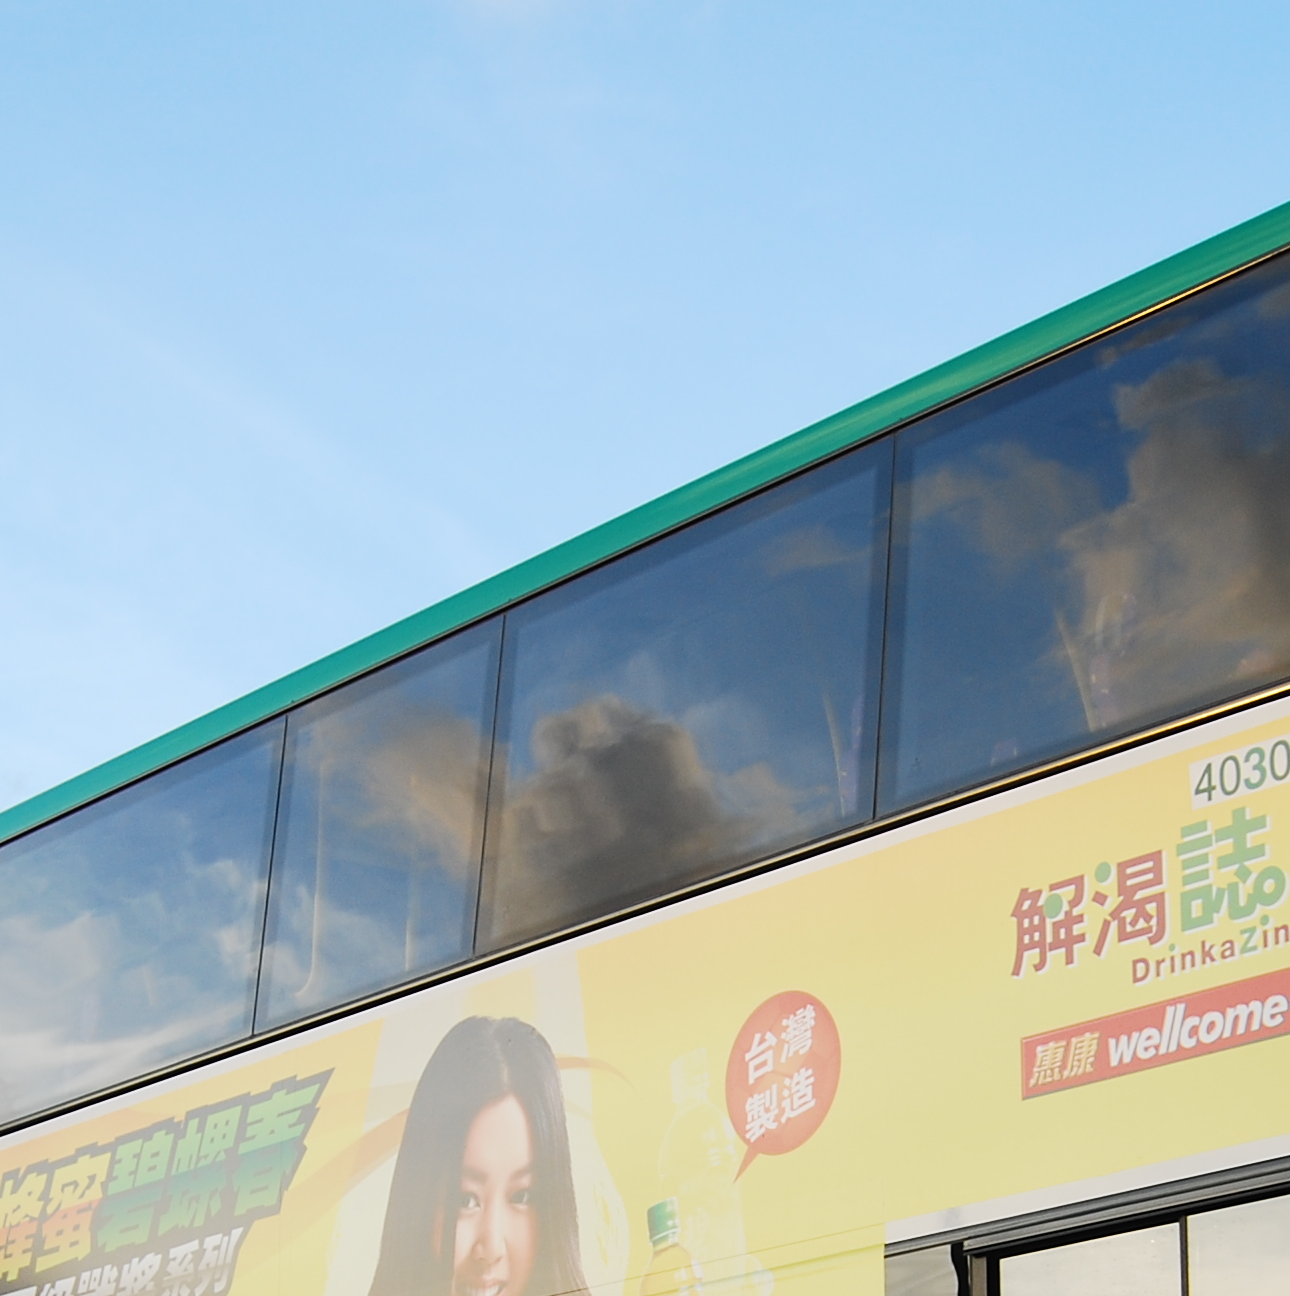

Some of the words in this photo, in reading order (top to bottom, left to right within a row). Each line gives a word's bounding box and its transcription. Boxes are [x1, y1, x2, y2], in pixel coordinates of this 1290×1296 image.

[1011, 806, 1287, 978] 解渴誌
[745, 1004, 816, 1085] 台灣
[1029, 1031, 1100, 1087] 惠康
[1108, 994, 1289, 1067] wellcome
[745, 1067, 816, 1143] 製造
